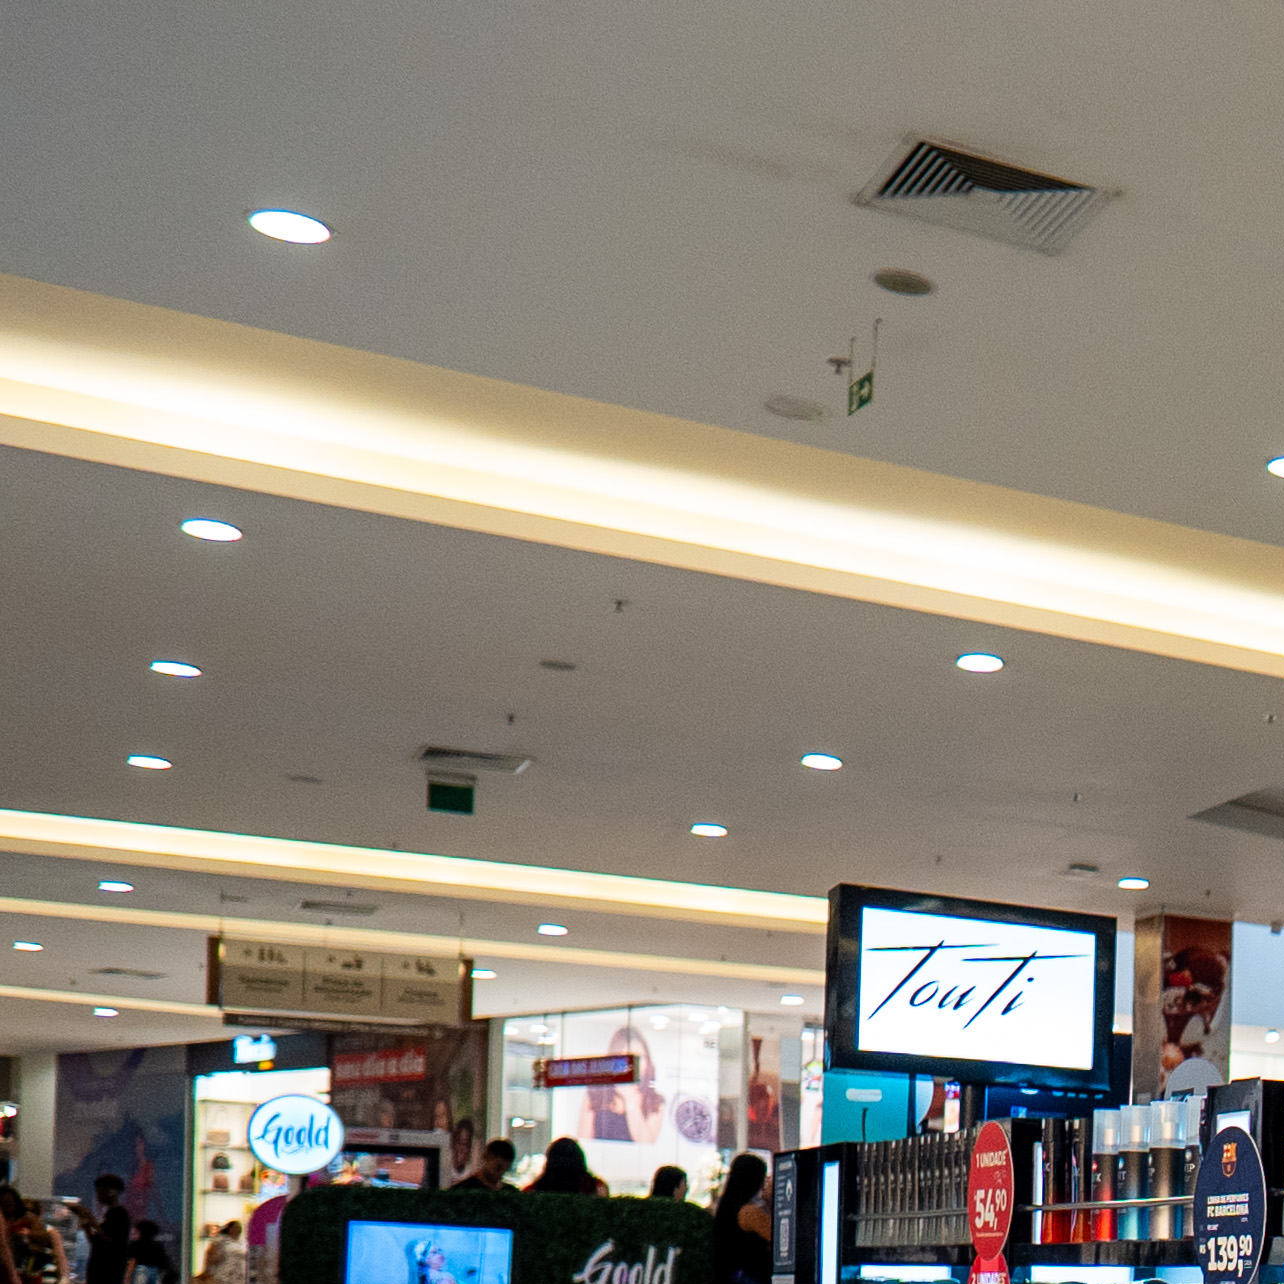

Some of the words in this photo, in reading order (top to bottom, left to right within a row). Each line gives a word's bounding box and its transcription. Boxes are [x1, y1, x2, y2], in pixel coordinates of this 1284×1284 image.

[866, 939, 1092, 1030] TouTi
[255, 1112, 331, 1159] Goold
[976, 1153, 980, 1168] 1
[1216, 1203, 1249, 1217] BARCELONA
[1207, 1234, 1252, 1277] 139,90
